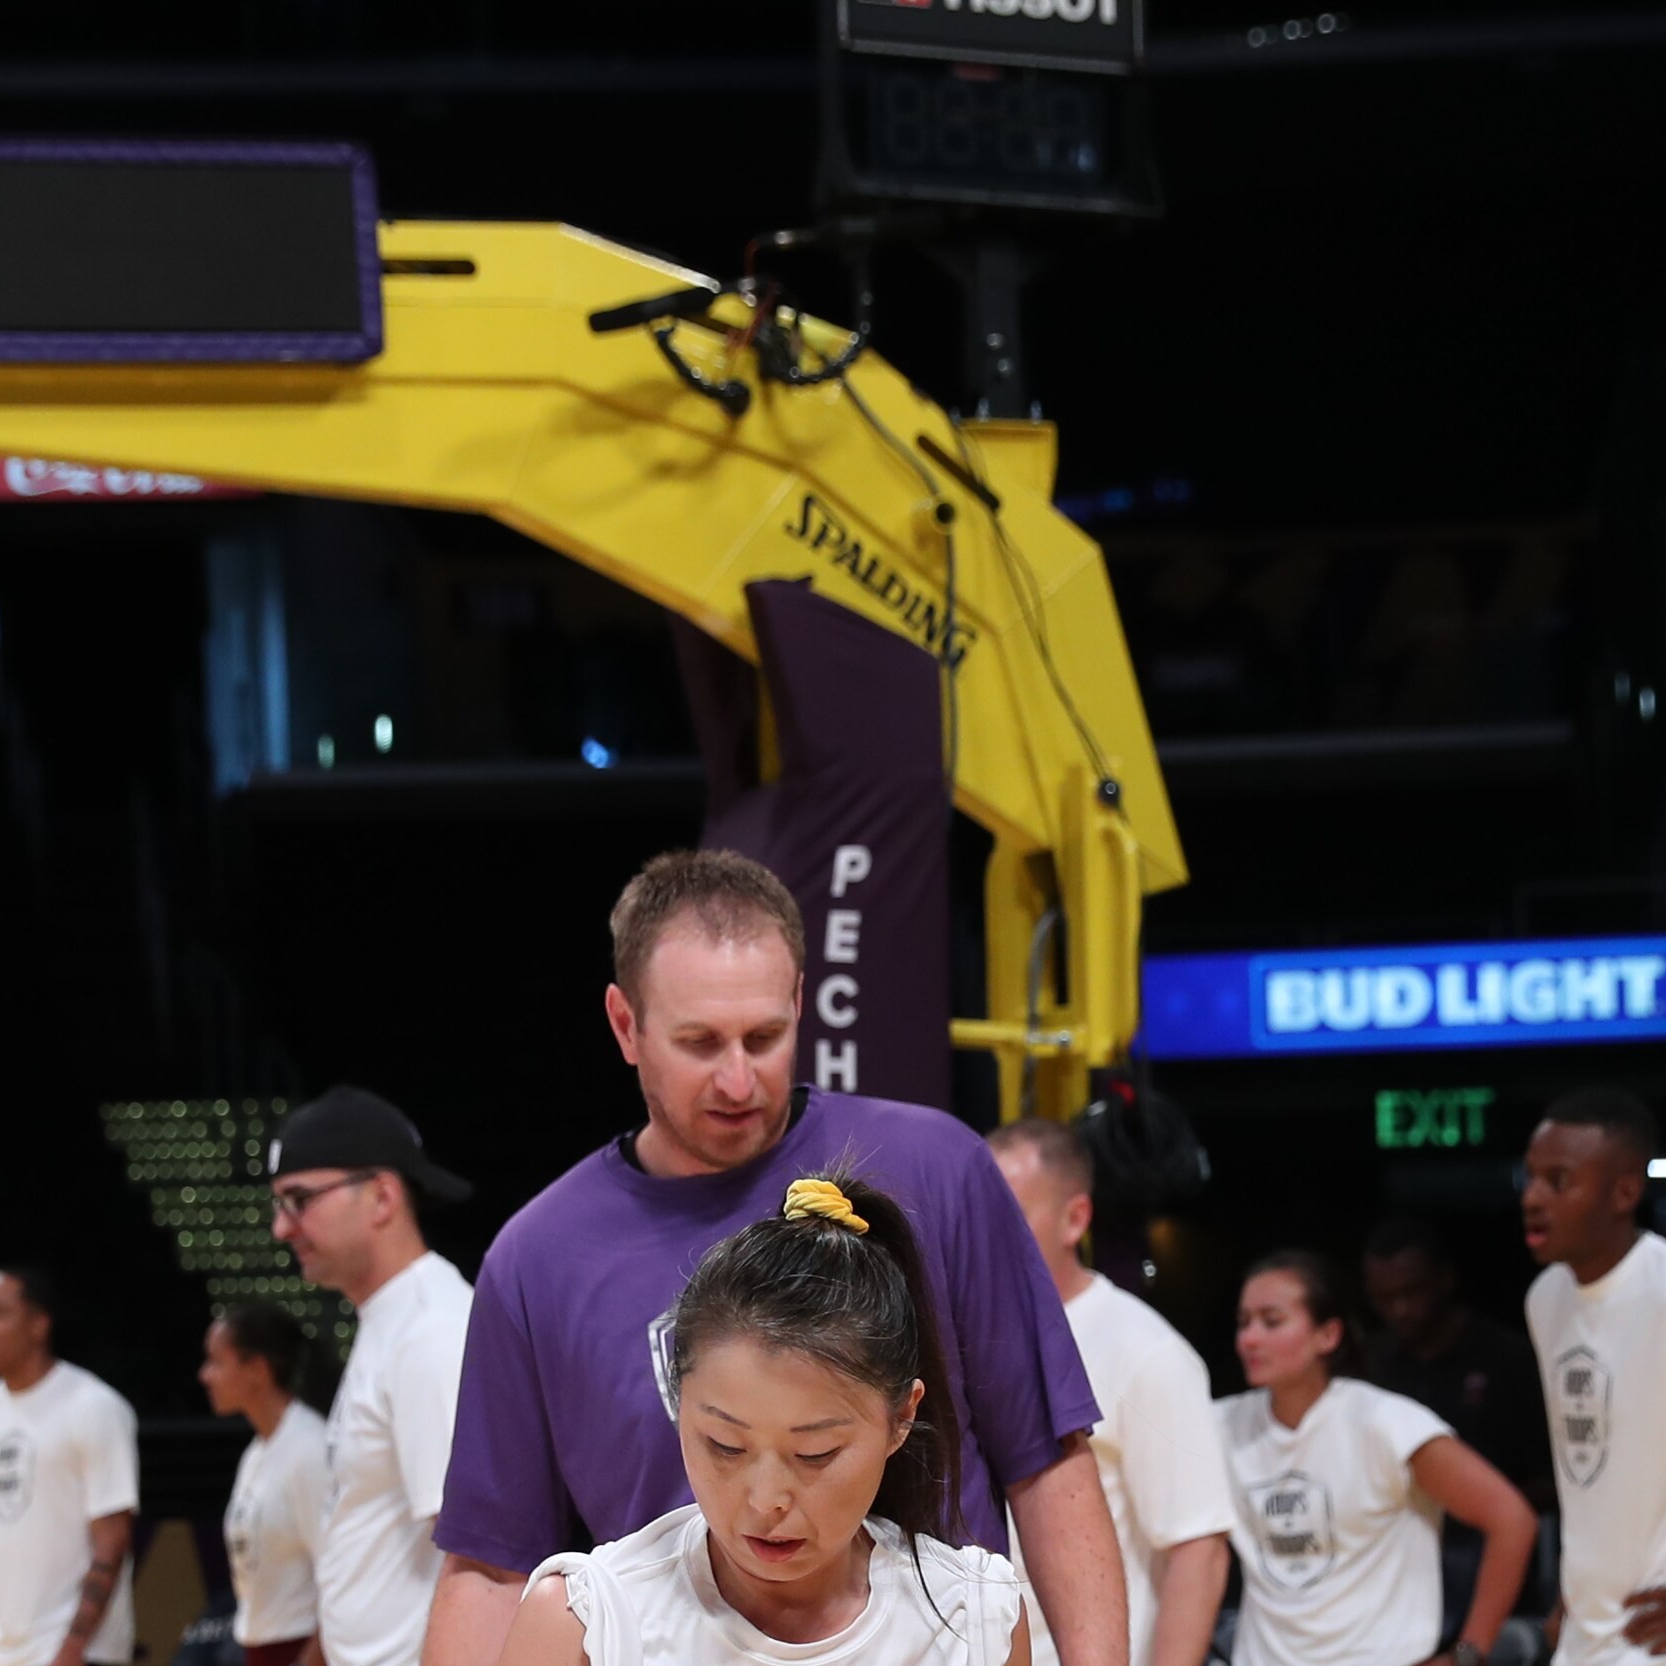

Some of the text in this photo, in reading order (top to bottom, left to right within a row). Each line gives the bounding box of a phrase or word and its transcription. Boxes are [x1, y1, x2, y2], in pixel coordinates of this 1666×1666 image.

[786, 496, 977, 668] SPALDING
[1264, 954, 1666, 1034] BUD LIGHT
[1374, 1088, 1495, 1147] EXIT
